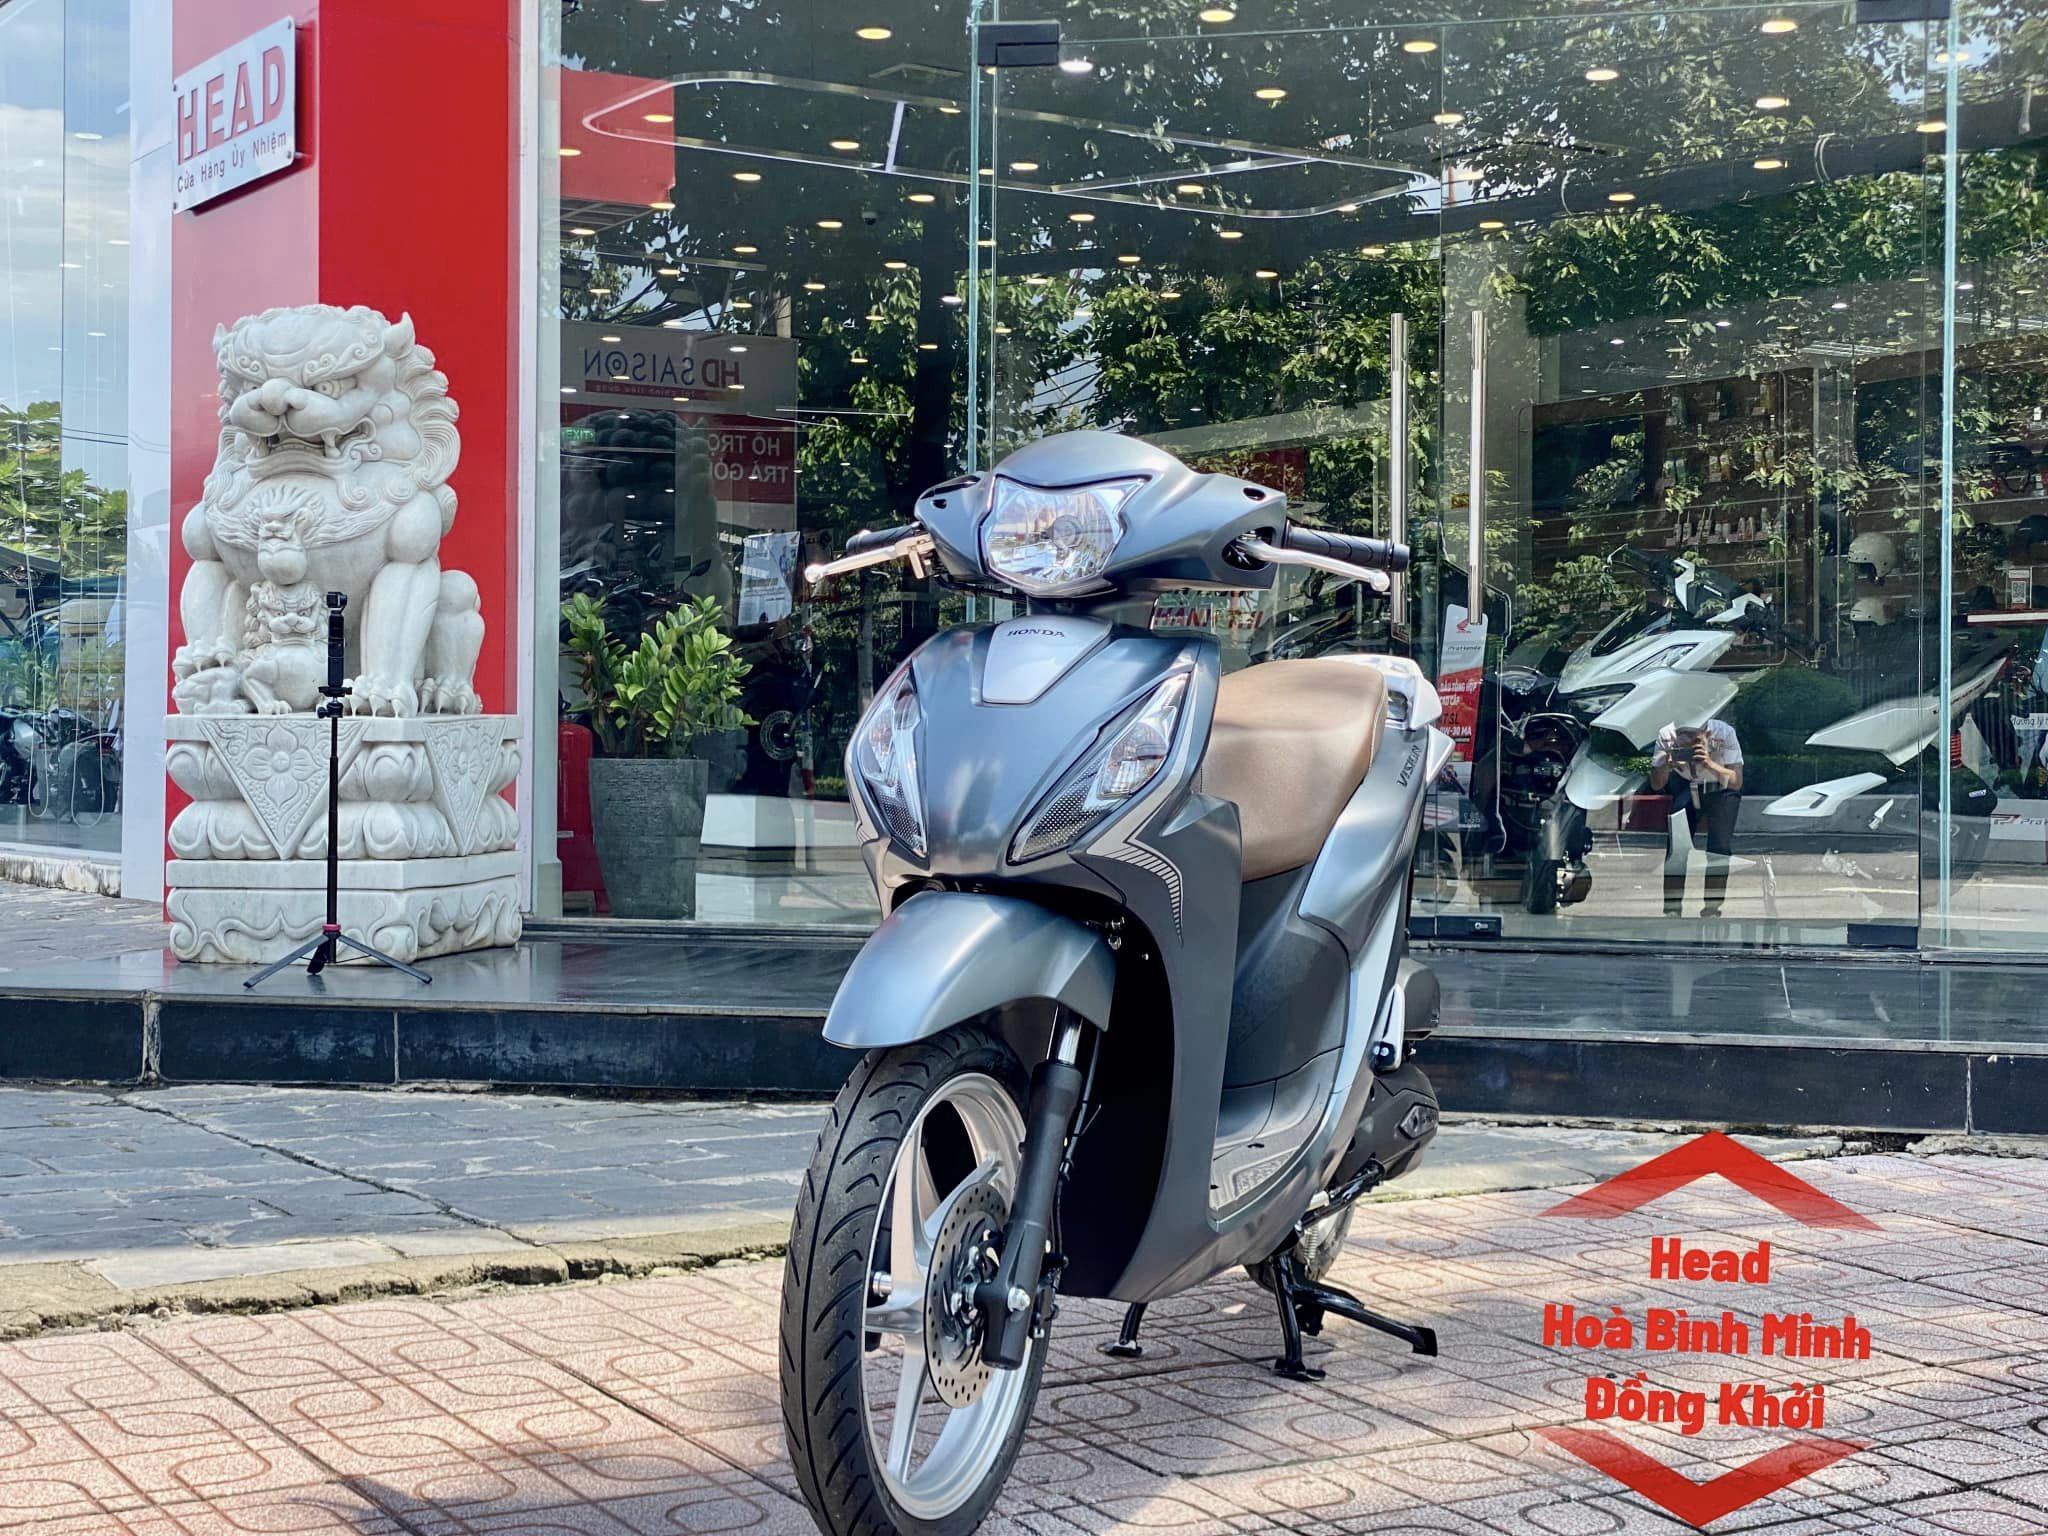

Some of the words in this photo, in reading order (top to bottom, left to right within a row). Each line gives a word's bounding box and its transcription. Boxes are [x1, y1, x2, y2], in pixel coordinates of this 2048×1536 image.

[177, 45, 286, 165] HEAD
[200, 158, 225, 183] Hàng
[252, 130, 287, 160] Nhiệm
[1007, 628, 1065, 638] HONDA
[1396, 744, 1421, 787] VISION
